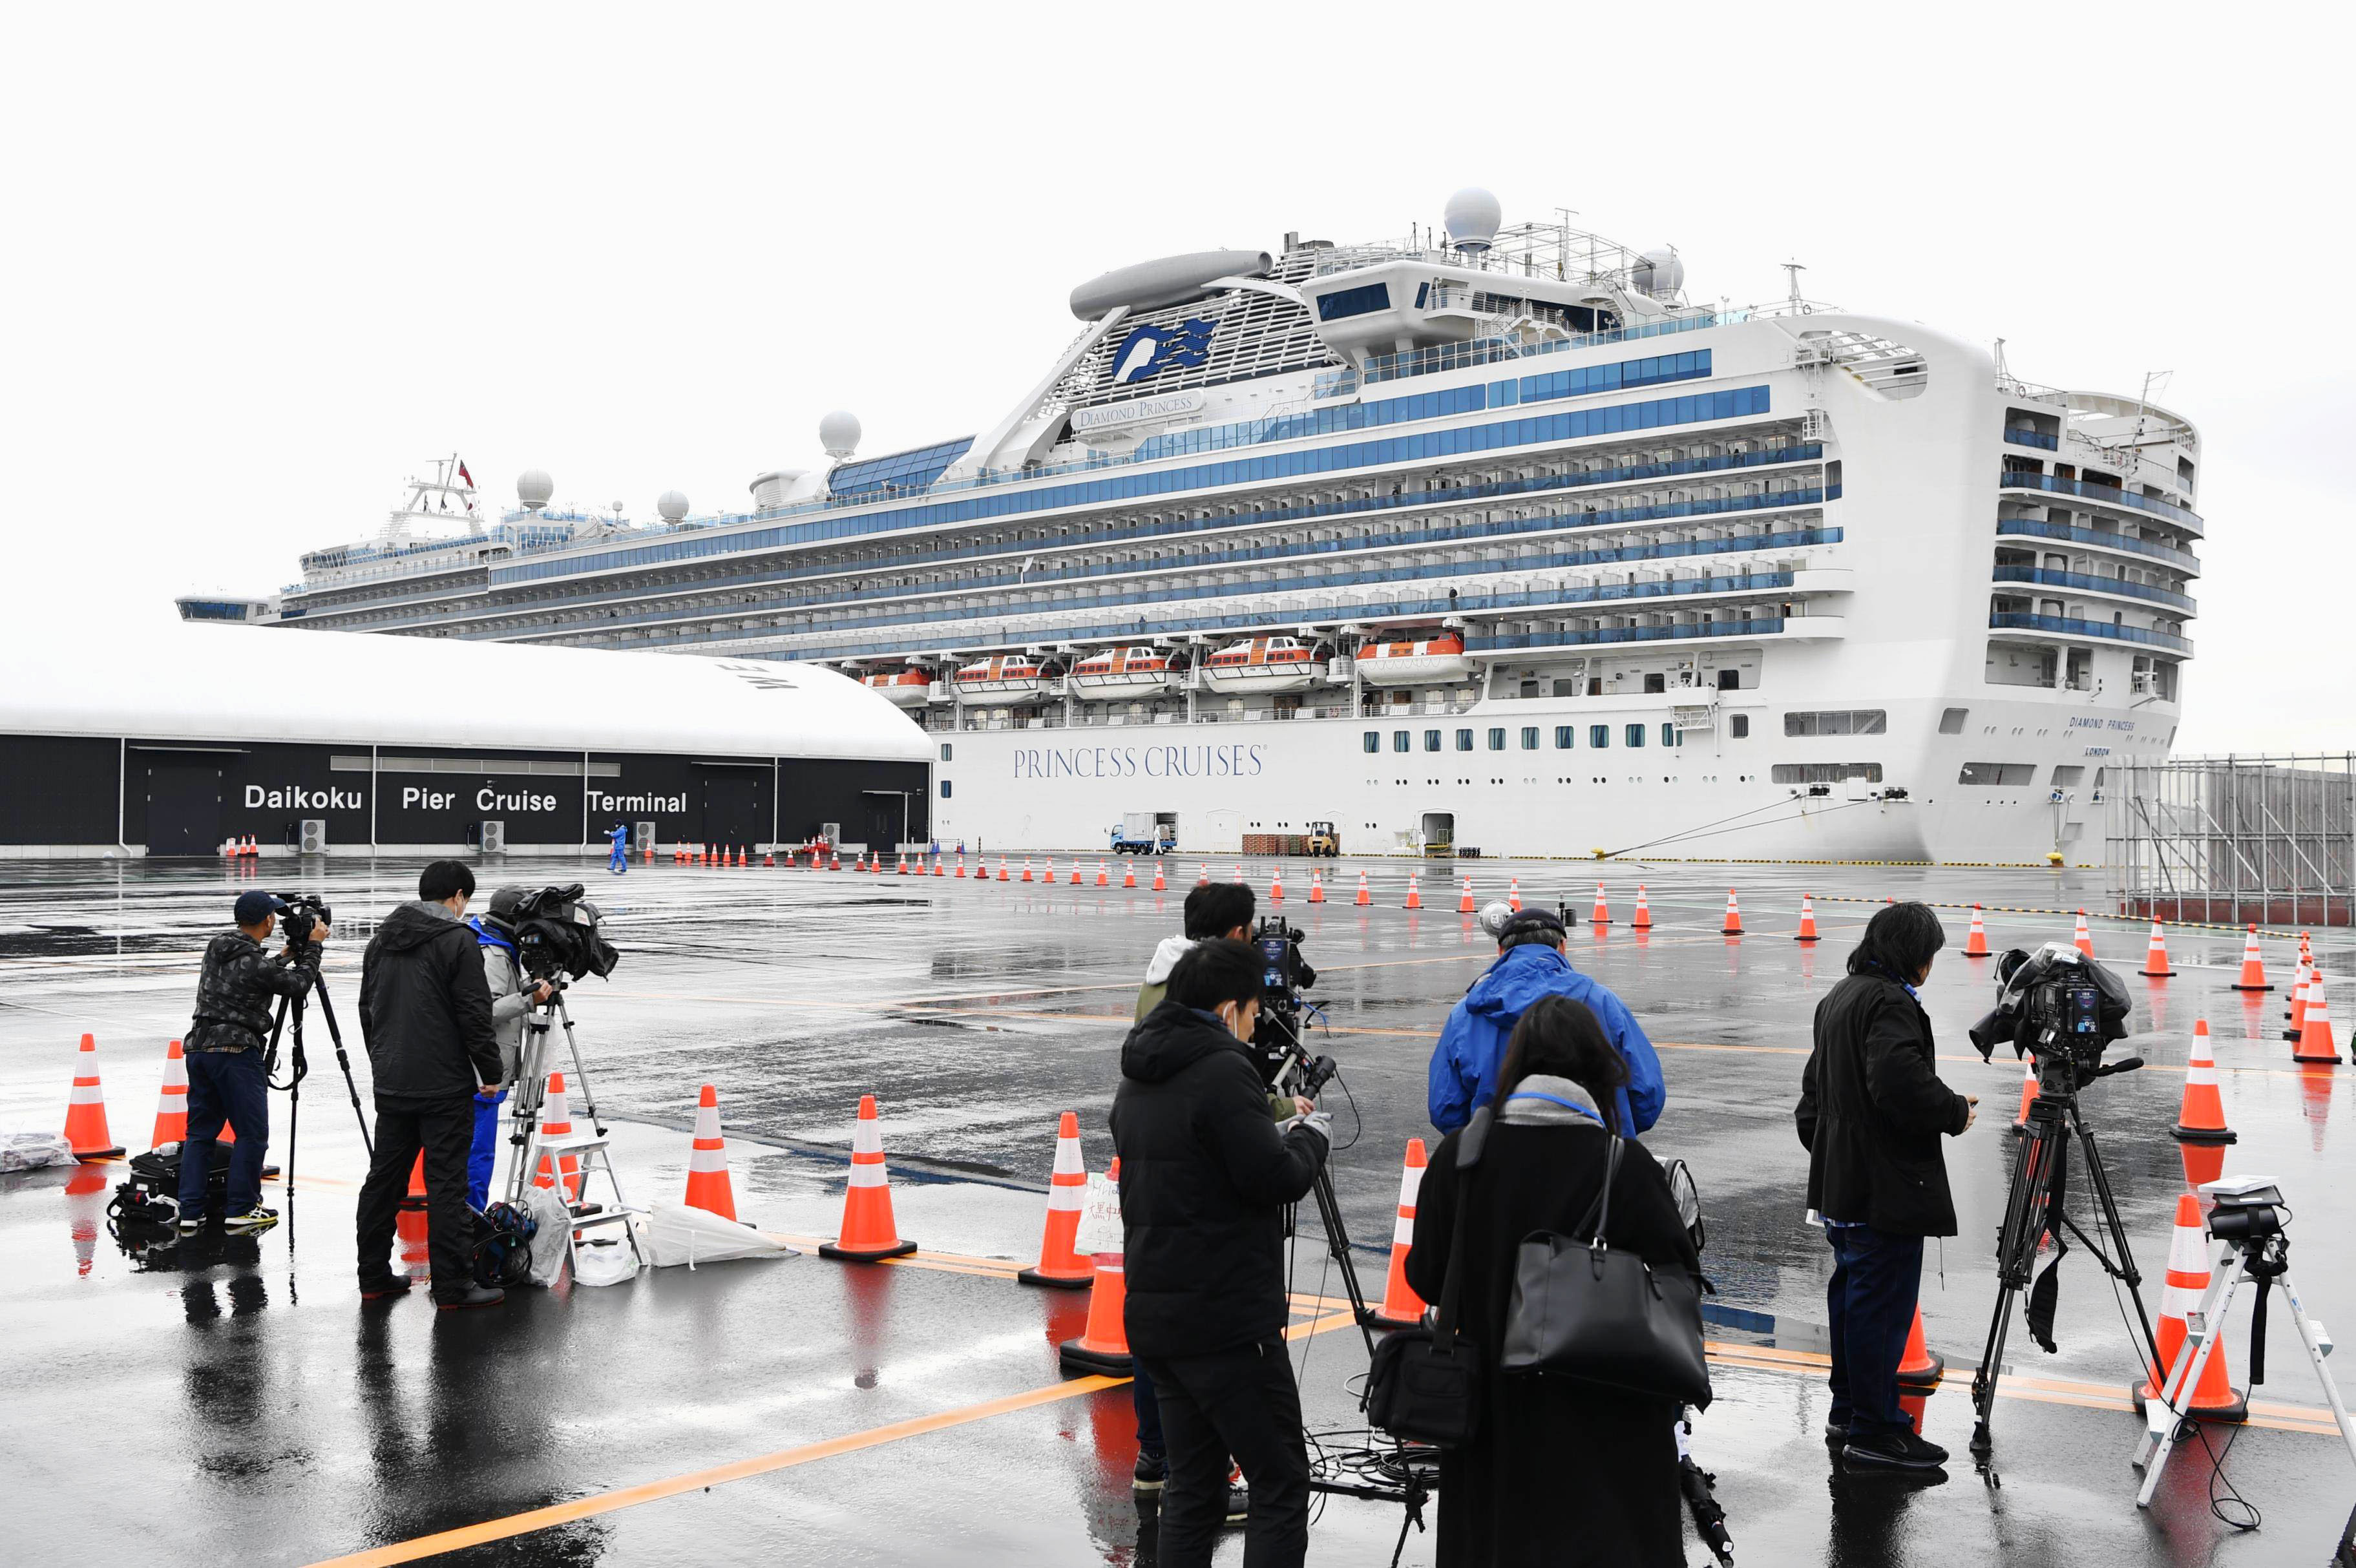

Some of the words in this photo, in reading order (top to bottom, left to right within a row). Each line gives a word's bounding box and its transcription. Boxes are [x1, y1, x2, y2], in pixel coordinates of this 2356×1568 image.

[1080, 407, 1135, 426] DIAMOND
[1139, 397, 1192, 417] PRINCESS
[2069, 717, 2103, 729] DIAMOND
[2107, 720, 2134, 731] PRINCESS
[1013, 747, 1136, 779] PRINCESS
[2085, 747, 2110, 756] LONDON
[245, 785, 362, 810] Daikoku
[403, 787, 456, 810] Pier
[476, 788, 556, 811] Cruise
[587, 791, 686, 813] Terminal
